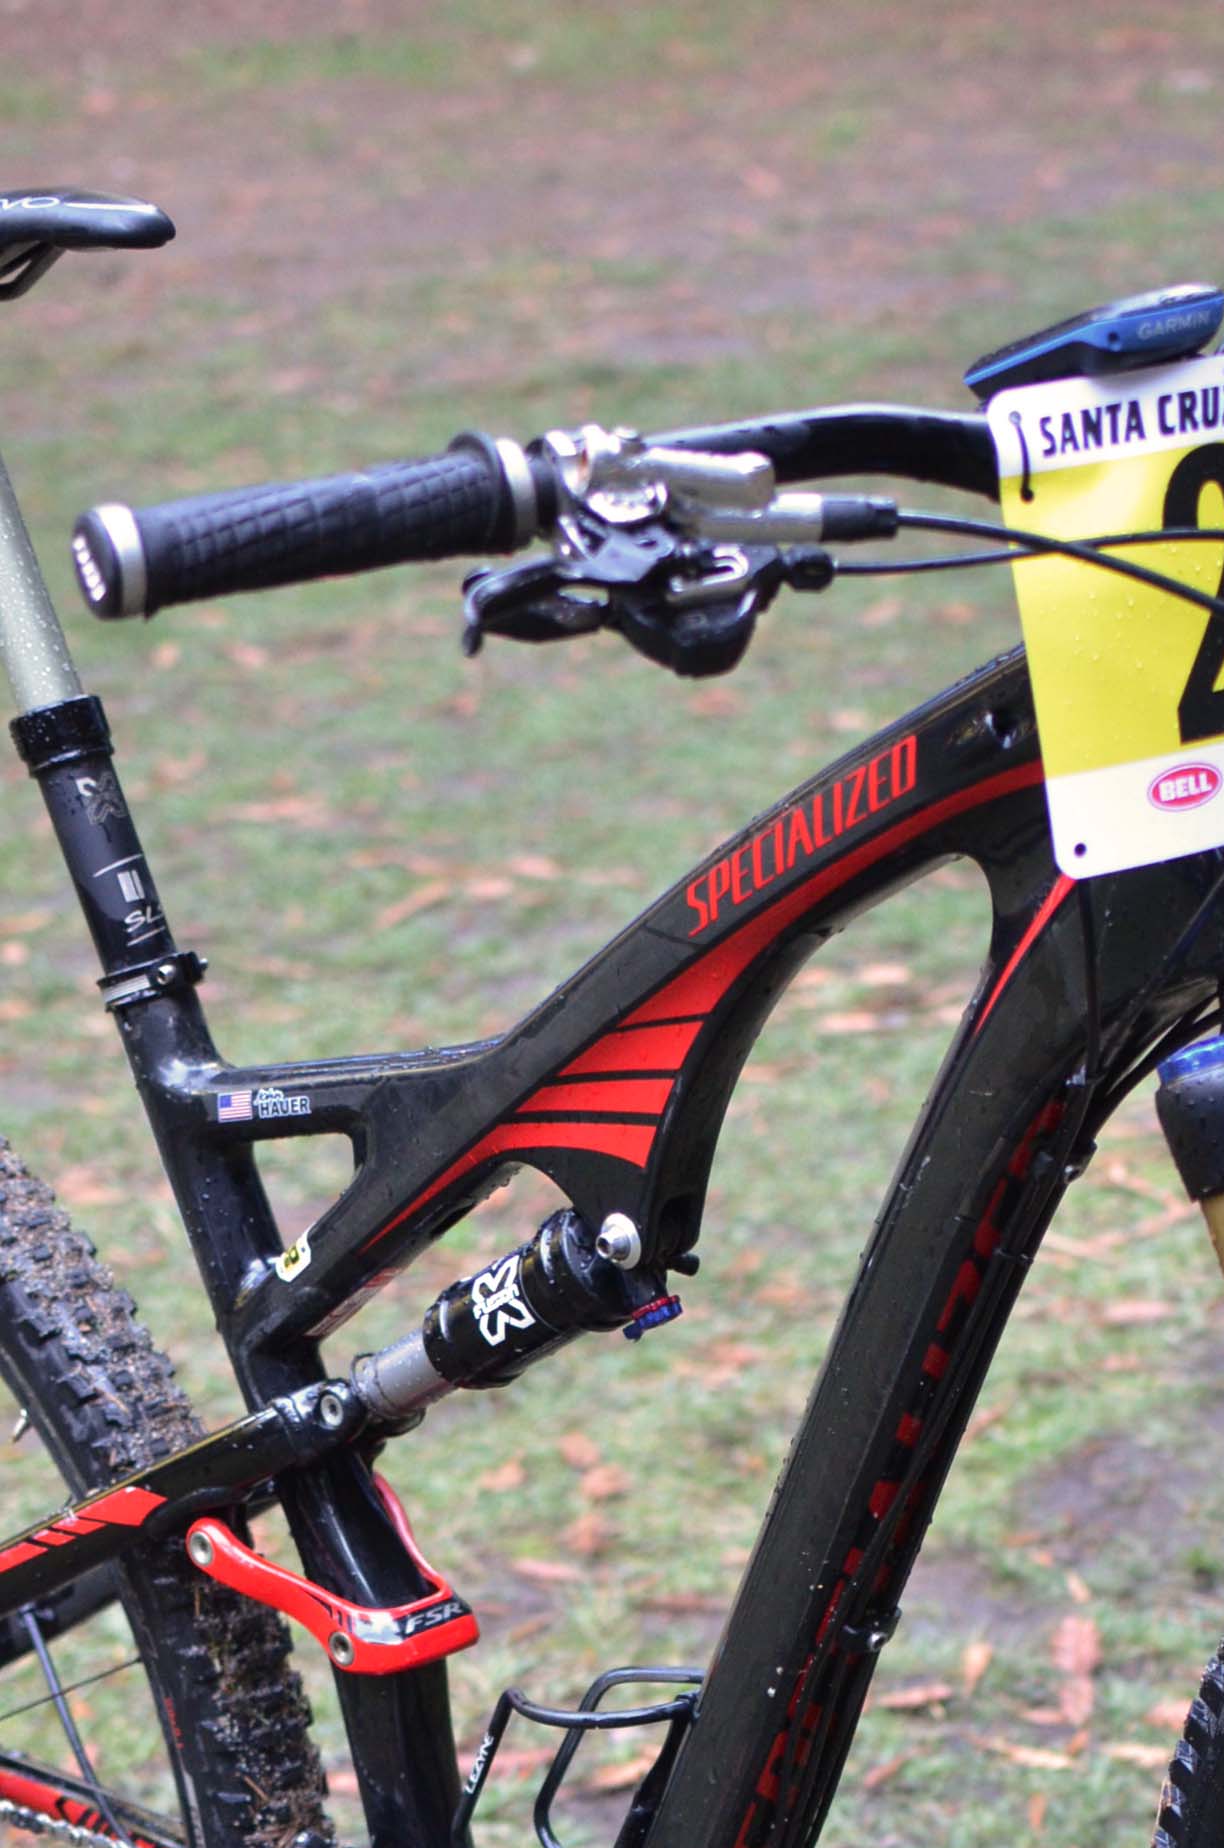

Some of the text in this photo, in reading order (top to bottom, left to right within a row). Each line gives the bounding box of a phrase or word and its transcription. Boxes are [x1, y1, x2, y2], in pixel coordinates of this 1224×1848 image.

[1137, 310, 1211, 340] GARMIN
[1040, 400, 1146, 458] SANTA
[1159, 772, 1213, 802] BELL
[686, 734, 918, 938] SPECIALIZED
[259, 1095, 311, 1118] HAUER
[405, 1602, 463, 1635] FSR
[463, 1734, 496, 1796] LEZYNE
